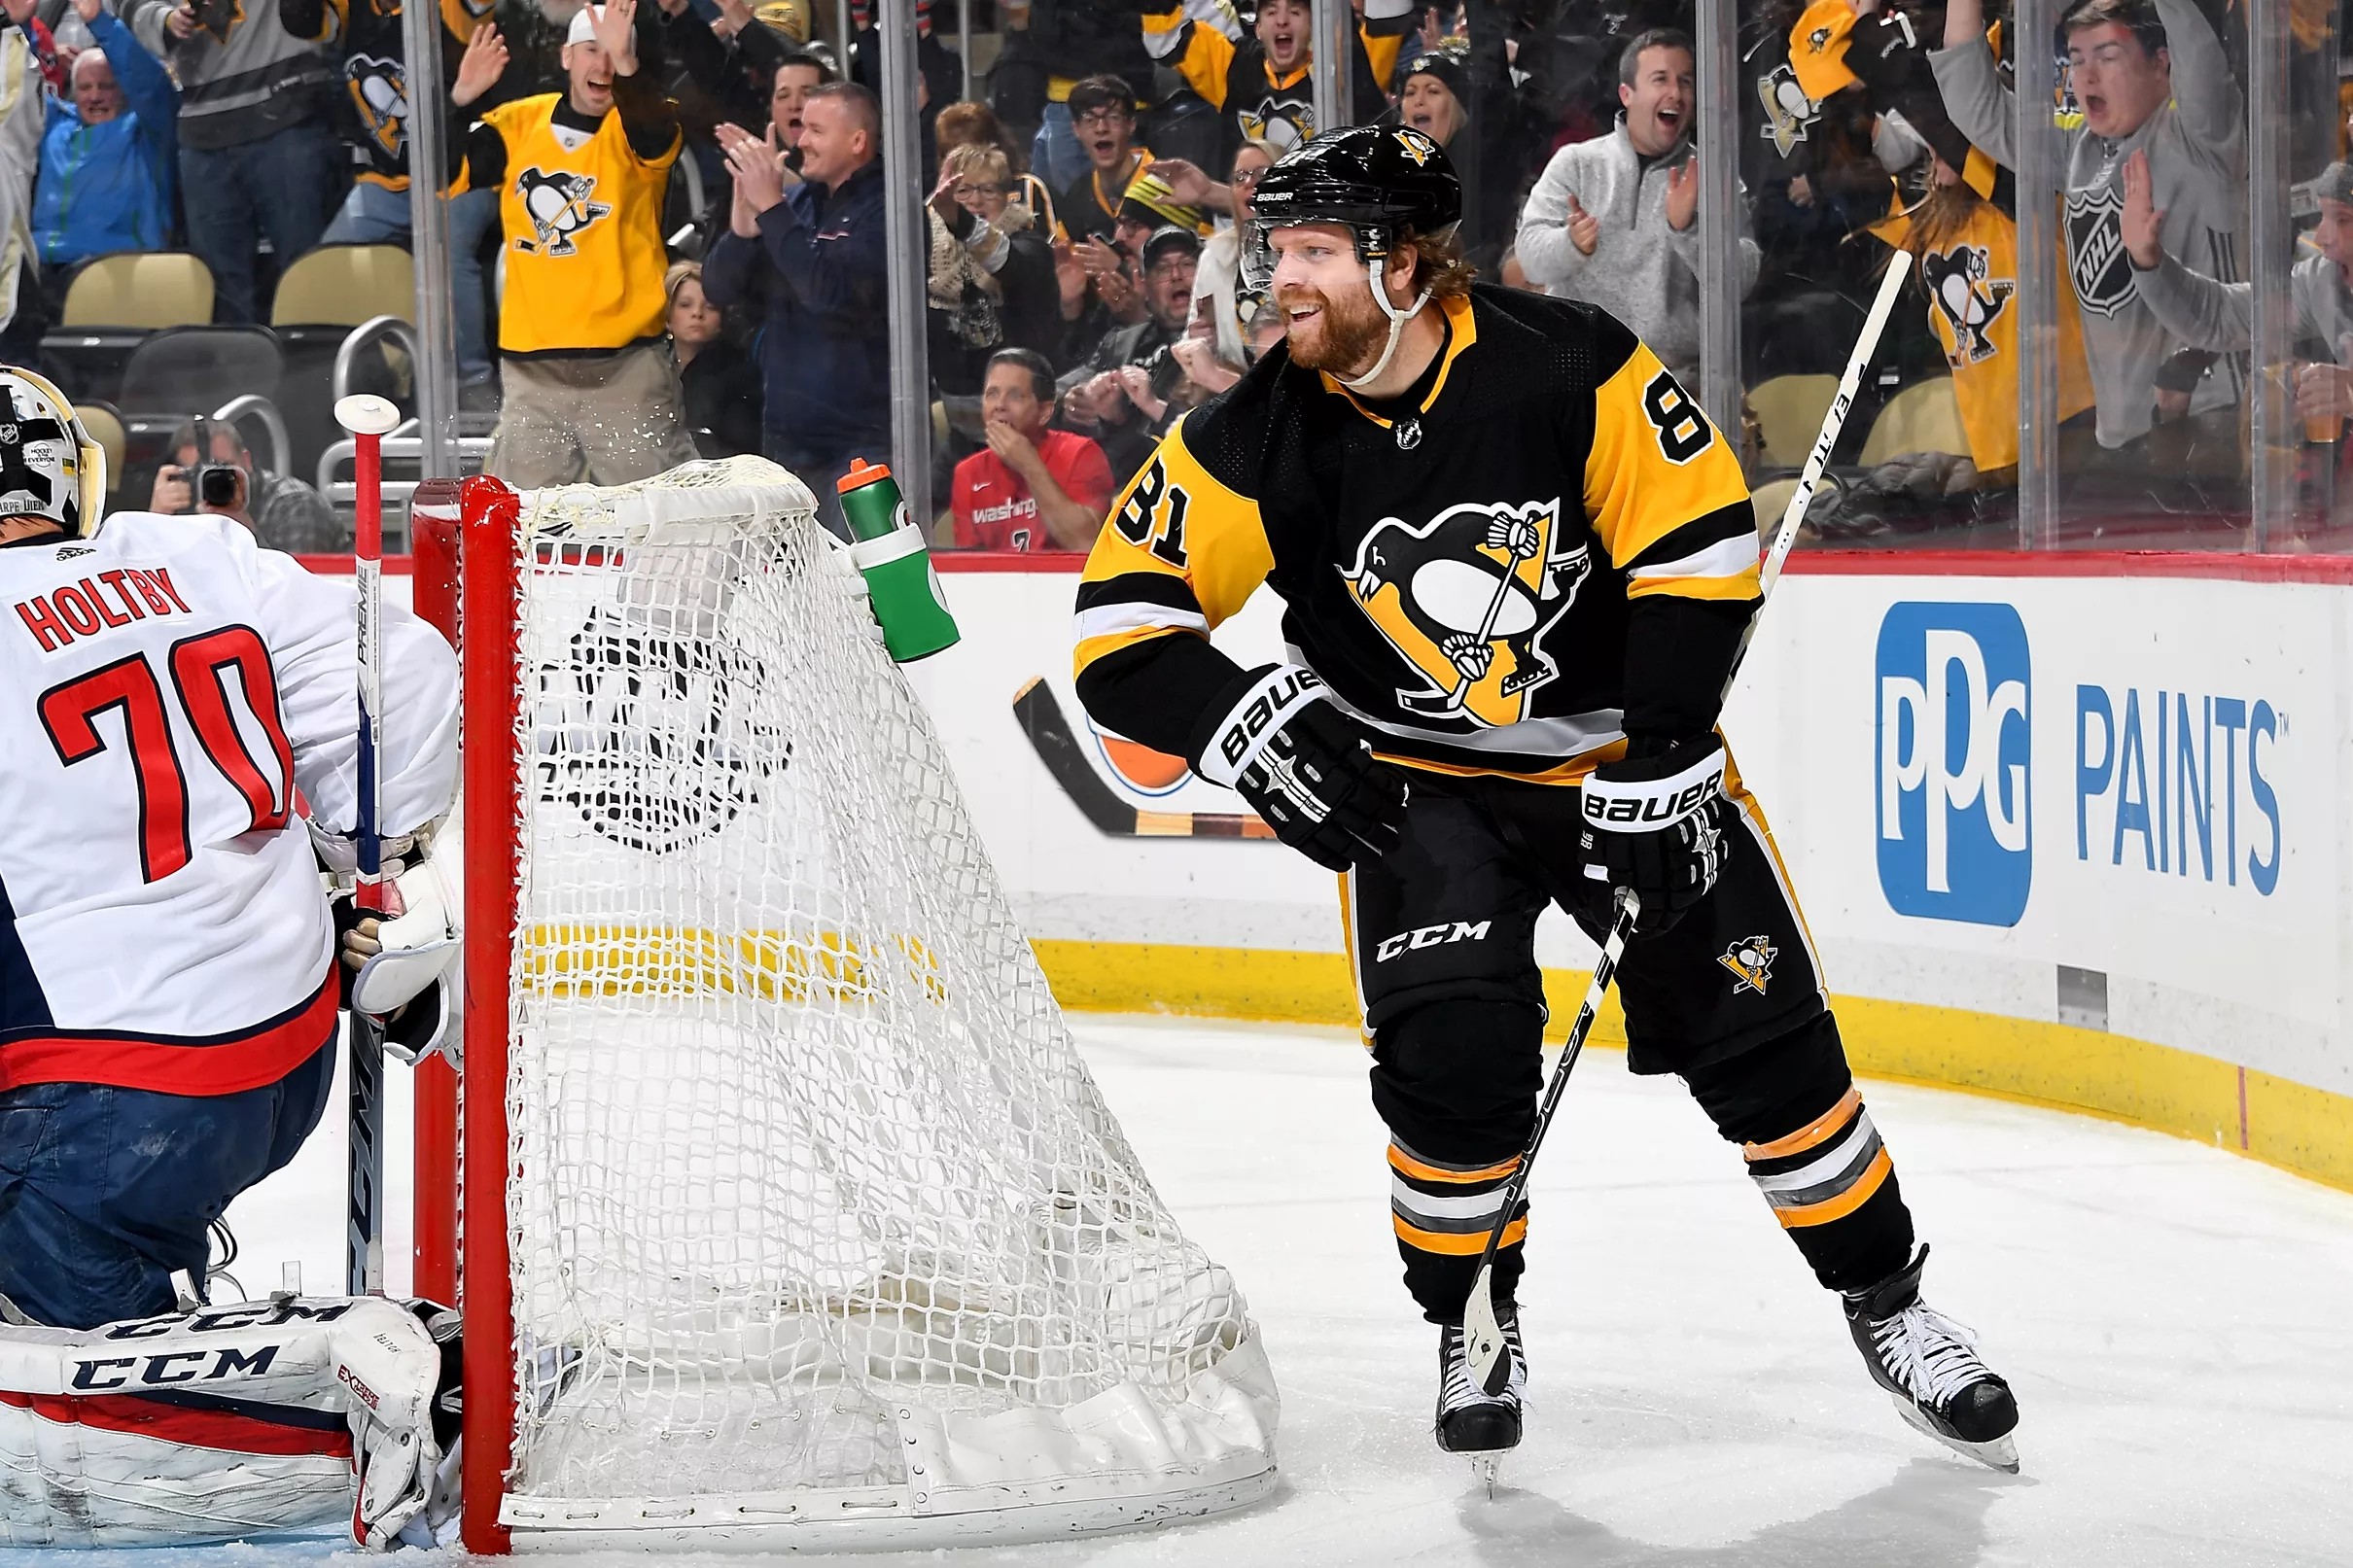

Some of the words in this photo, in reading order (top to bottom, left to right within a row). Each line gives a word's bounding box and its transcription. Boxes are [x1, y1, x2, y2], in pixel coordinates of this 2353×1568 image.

[1256, 192, 1294, 202] BAUER
[2080, 223, 2121, 294] NHL
[973, 497, 1037, 524] washing
[1113, 451, 1192, 571] 81
[15, 568, 193, 652] HOLTBY
[1220, 669, 1322, 769] BAUE
[37, 623, 295, 886] 70
[1881, 629, 2026, 892] PPG
[2076, 683, 2281, 896] PAINTS
[1584, 768, 1723, 822] BAUER
[1376, 920, 1493, 963] CCM
[105, 1301, 354, 1340] CCM
[71, 1344, 281, 1390] CCM
